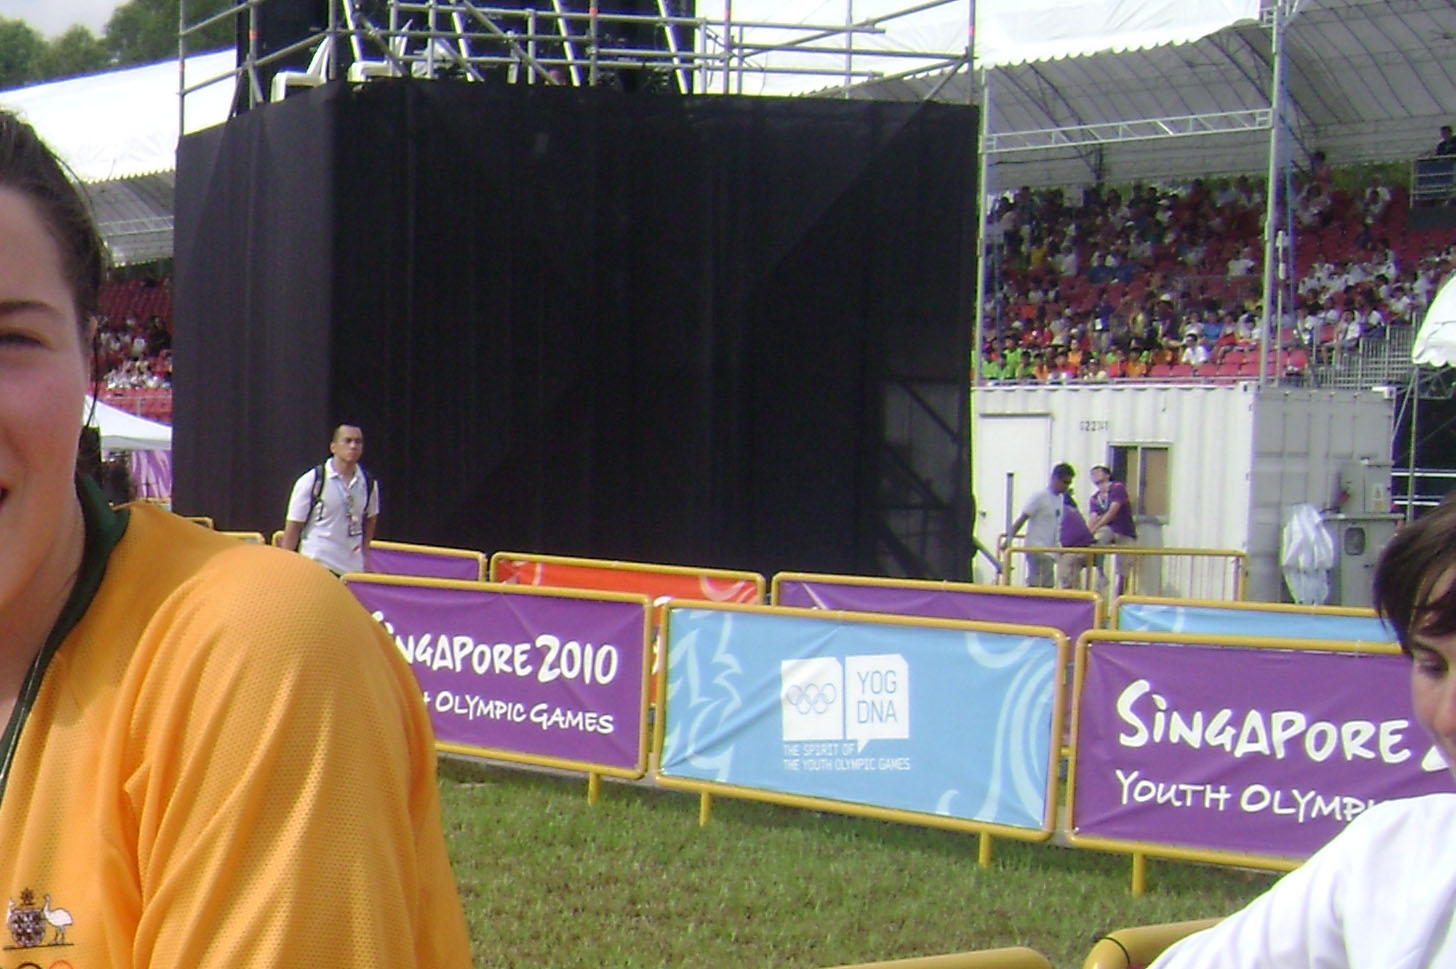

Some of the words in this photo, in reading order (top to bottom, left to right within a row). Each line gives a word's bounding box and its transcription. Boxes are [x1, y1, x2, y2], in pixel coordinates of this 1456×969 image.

[535, 634, 619, 685] 2010
[857, 670, 897, 694] YOG
[435, 691, 527, 721] OLYMPIC
[529, 703, 615, 734] GAMES
[857, 700, 898, 724] DNA
[783, 743, 800, 756] THE
[803, 743, 838, 756] SPIRIT
[841, 743, 855, 756] OF
[783, 758, 800, 771] THE
[802, 758, 832, 771] YOUTH
[834, 758, 875, 771] OLYMPIC
[878, 757, 911, 770] GAMES
[1115, 769, 1232, 811] YOUTH
[1241, 784, 1375, 823] OLYMP
